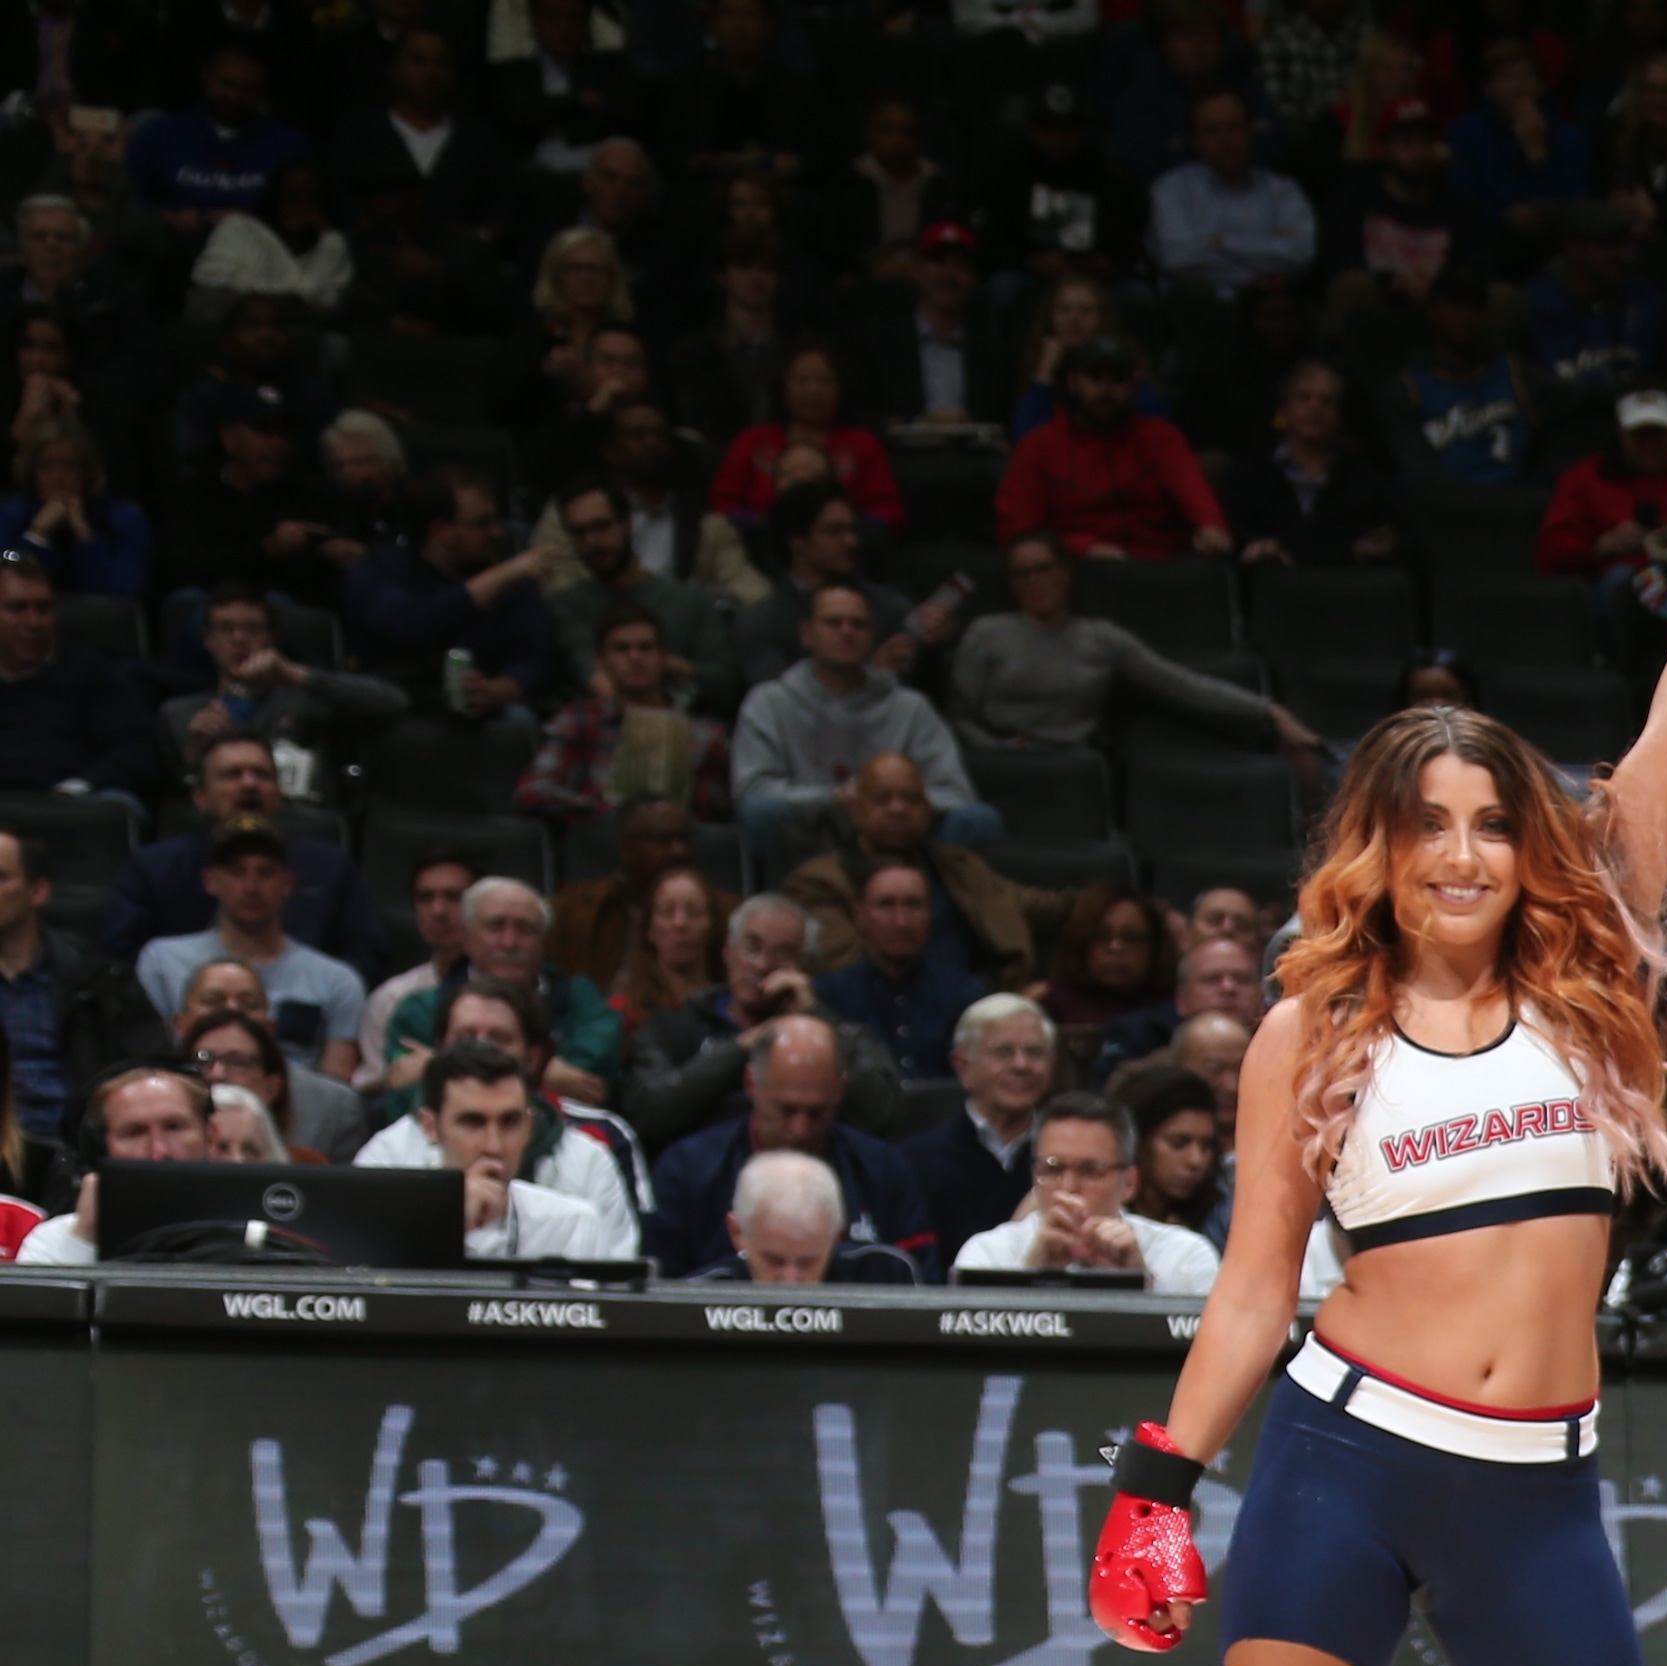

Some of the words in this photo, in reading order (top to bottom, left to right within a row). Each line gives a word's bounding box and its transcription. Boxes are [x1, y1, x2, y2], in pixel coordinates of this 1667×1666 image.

[222, 1292, 366, 1321] WGL.COM
[467, 1301, 606, 1328] #ASKWGL
[705, 1306, 842, 1332] WGL.COM
[939, 1311, 1072, 1337] #ASKWGL
